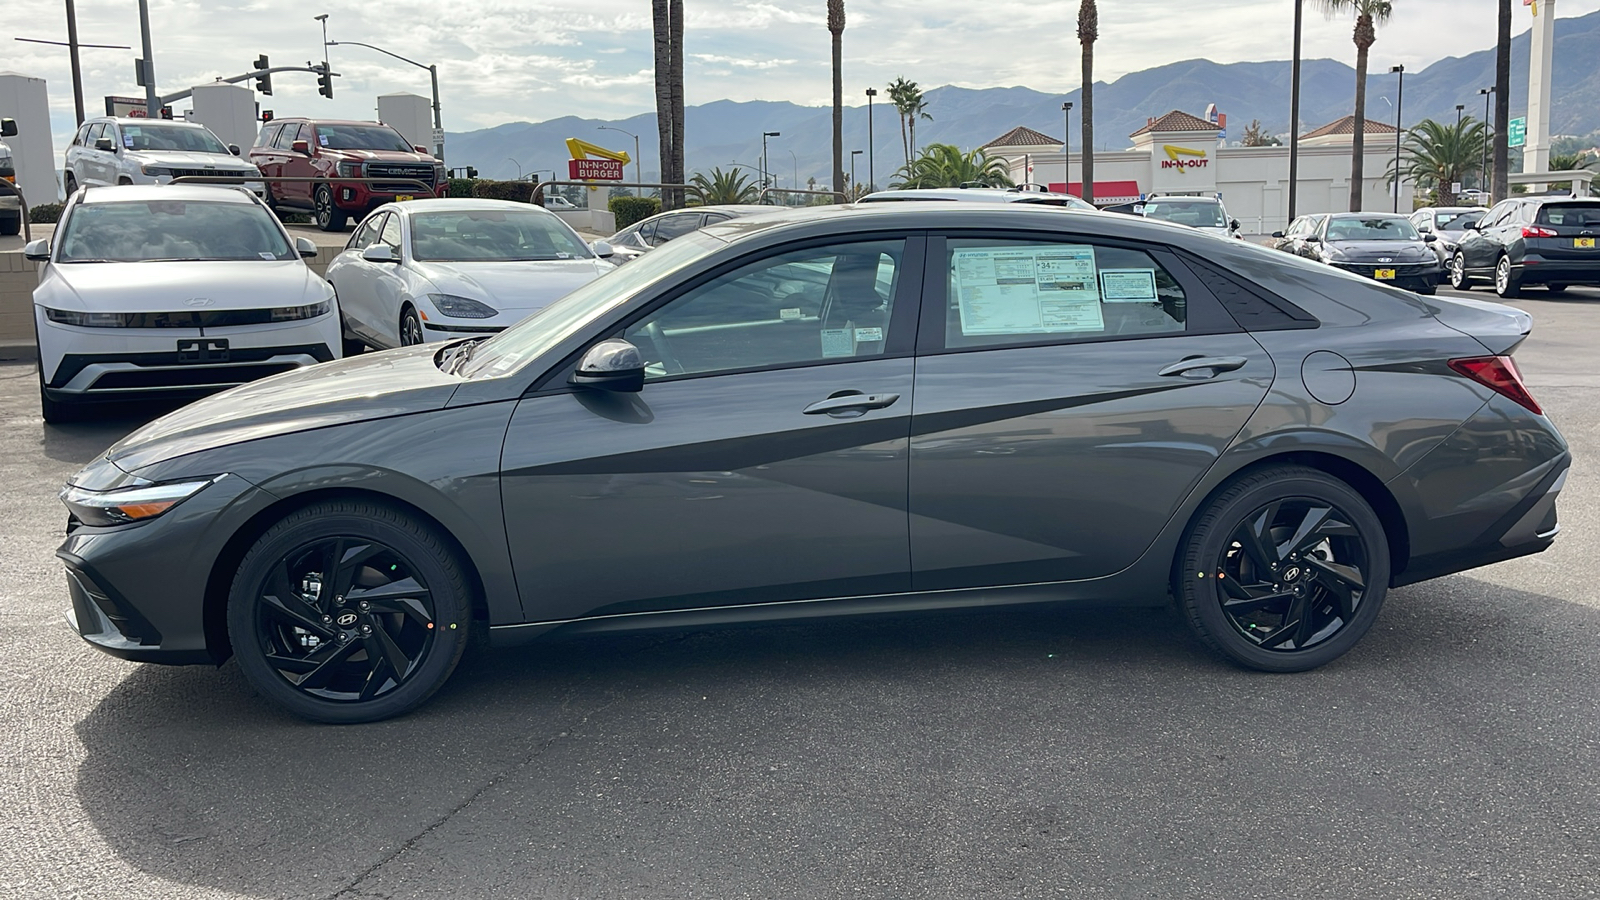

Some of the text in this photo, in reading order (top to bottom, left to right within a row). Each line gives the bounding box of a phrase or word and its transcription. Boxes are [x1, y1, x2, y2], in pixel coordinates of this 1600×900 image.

[578, 161, 620, 170] IN-N-OUT
[1161, 159, 1209, 168] IN-N-OUT
[579, 169, 620, 178] BURGER
